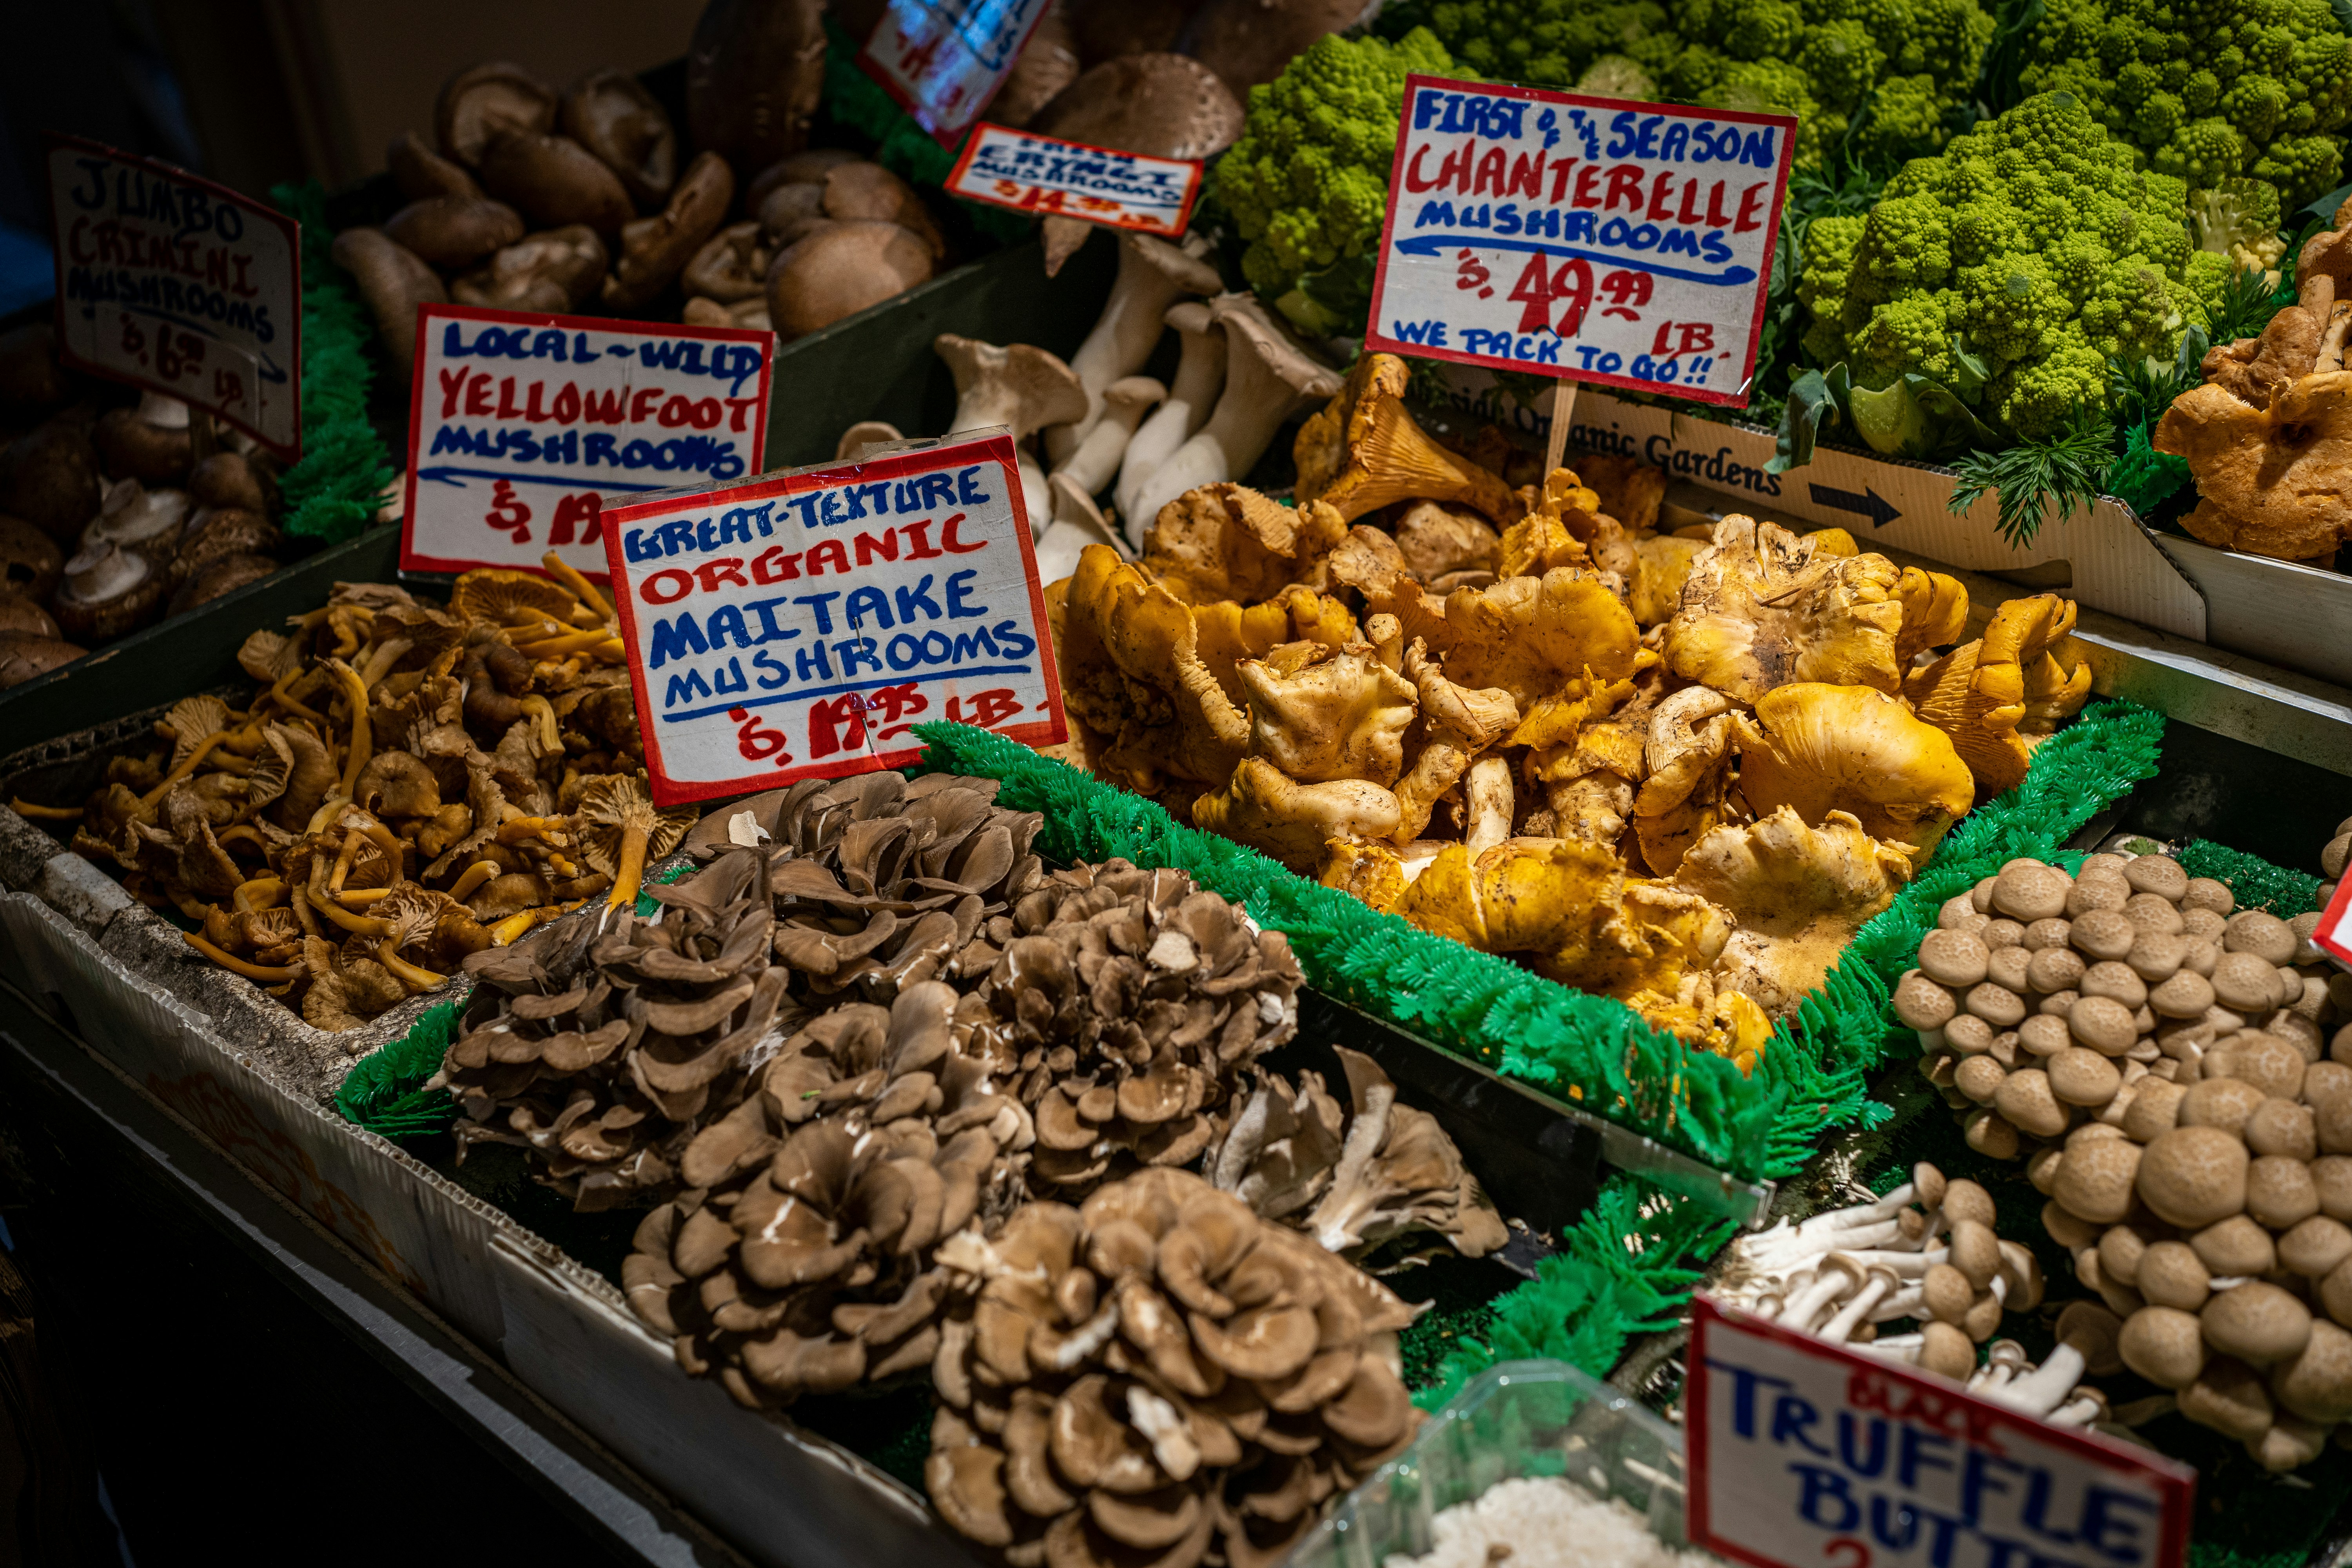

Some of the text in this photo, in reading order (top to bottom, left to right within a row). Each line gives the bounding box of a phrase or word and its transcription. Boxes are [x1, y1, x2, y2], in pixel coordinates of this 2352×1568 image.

[1414, 90, 1776, 169] FIRST OF THE SEASON
[72, 158, 243, 248] JUMBO
[971, 160, 1181, 201] MUSHROOMS
[1405, 138, 1770, 234] CHANTERELLE
[69, 216, 258, 297] CRIMINI
[1414, 200, 1733, 264] MUSHROOMS
[68, 268, 273, 342] MUSHROOMS
[1394, 319, 1447, 346] WE
[1459, 328, 1563, 363] PACK
[1575, 345, 1622, 374] TO
[439, 365, 760, 433] YELLOWFOOT
[430, 424, 744, 481] MUSHROOMS
[1515, 405, 1782, 496] Oranic Gardens
[640, 513, 988, 605] ORGANIC
[649, 569, 988, 669] MAITAKE
[664, 620, 1036, 708] MUSHROOMS
[1702, 1357, 2159, 1566] TRUFFLE
